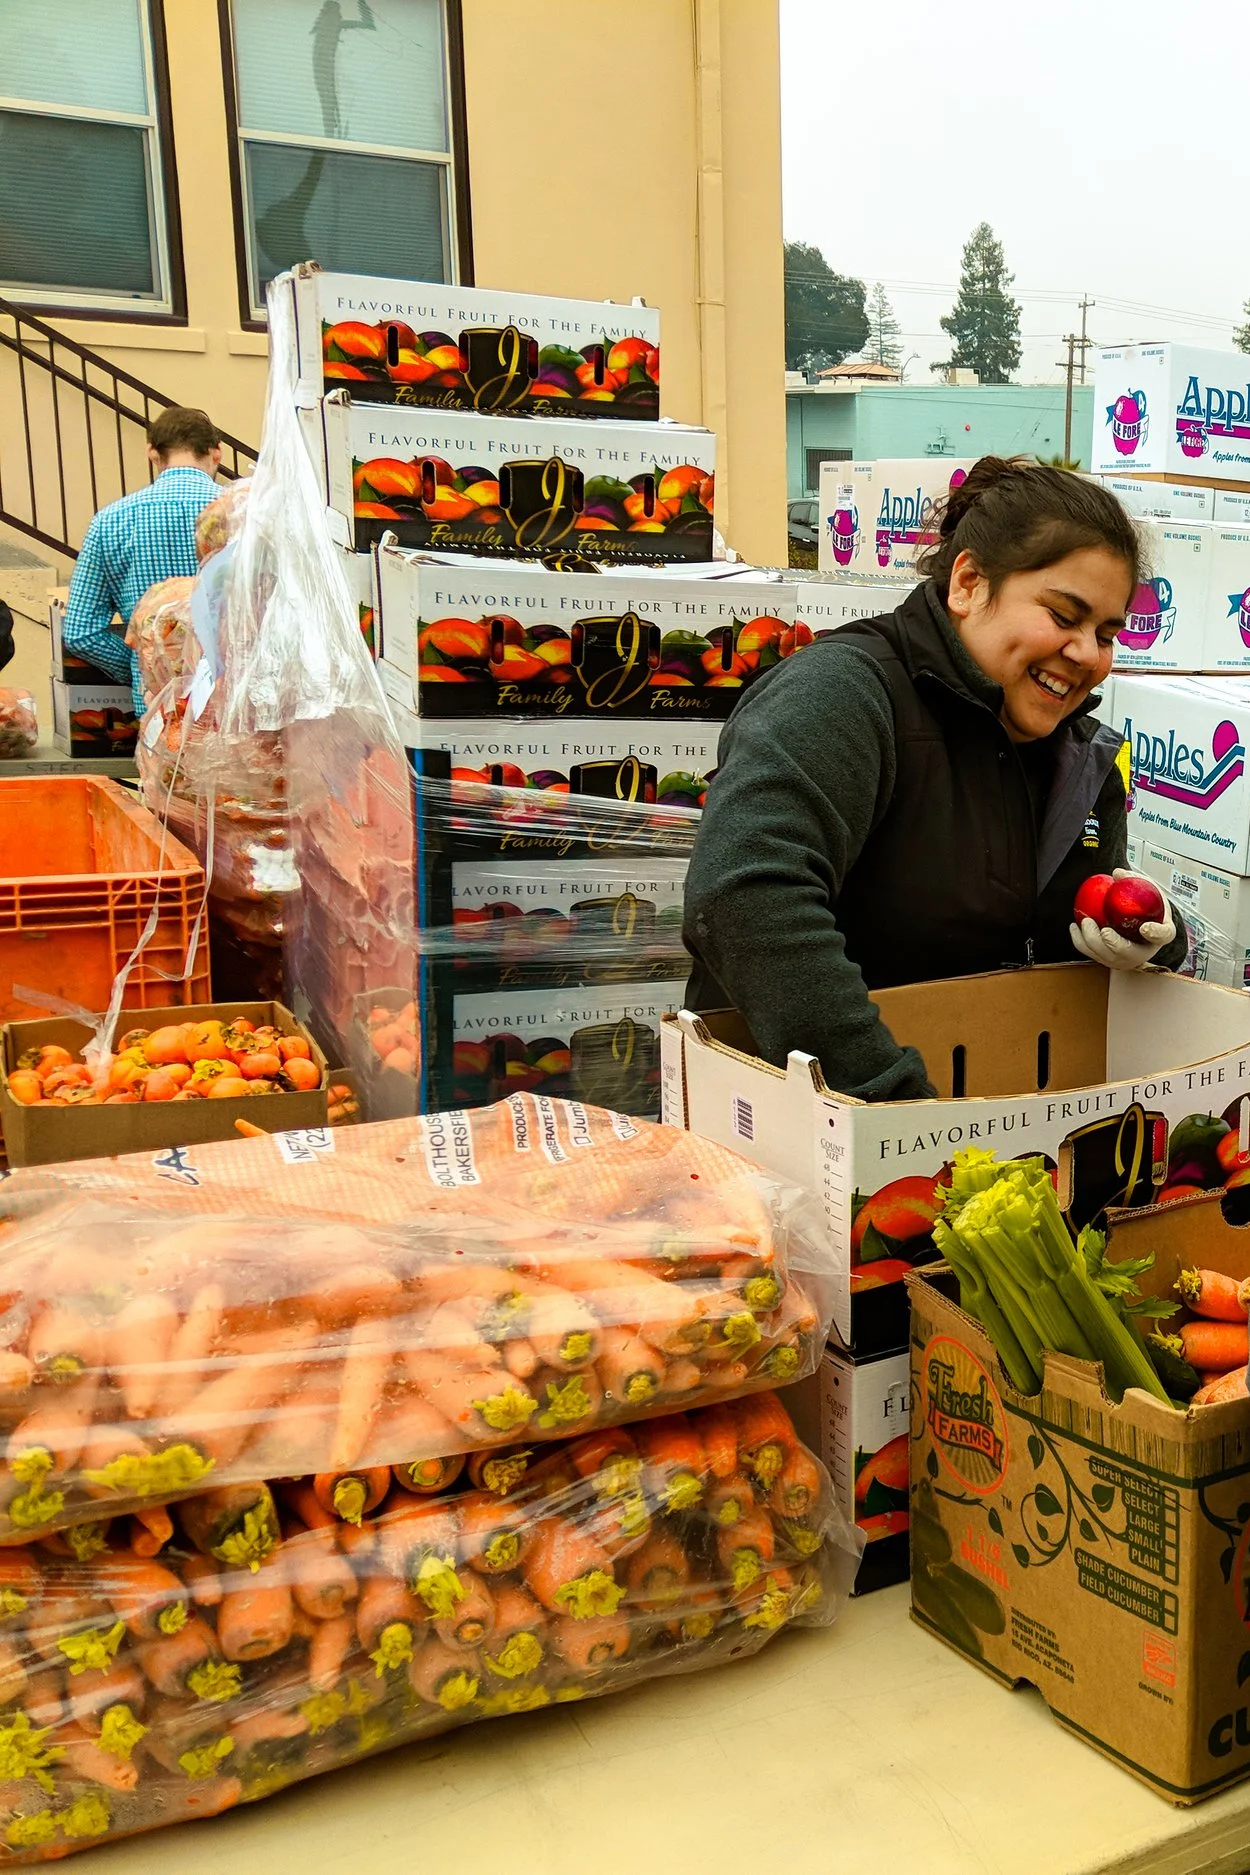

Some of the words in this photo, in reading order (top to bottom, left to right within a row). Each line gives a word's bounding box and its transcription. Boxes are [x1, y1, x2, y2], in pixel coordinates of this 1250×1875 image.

[337, 297, 437, 318] FLAVORFUL
[447, 308, 498, 323] FRUIT
[508, 314, 540, 328] FOR
[550, 319, 580, 333] THE
[591, 323, 647, 338] FAMILY
[368, 432, 477, 451] FLAVORFUL
[487, 440, 541, 456] FRUIT
[553, 445, 586, 459] FOR
[596, 448, 630, 462] THE
[640, 451, 701, 467] FAMILY
[1212, 451, 1235, 463] Apples
[1235, 454, 1250, 464] from
[431, 524, 504, 547] Family
[578, 532, 638, 551] Farms
[434, 591, 548, 609] FLAVORFUL
[559, 597, 616, 611] FRUIT
[627, 600, 663, 613] FOR
[671, 602, 708, 615] THE
[717, 603, 782, 618] FAMILY
[1159, 581, 1170, 603] 4
[1130, 613, 1162, 631] FORE
[496, 685, 574, 715] Family
[650, 691, 711, 711] Farms
[440, 743, 550, 755] FLAVORFUL
[562, 743, 617, 756] FRUIT
[628, 743, 663, 756] FOR
[672, 744, 707, 756] THE
[1122, 717, 1205, 787] Apples
[500, 830, 575, 857] Family
[1138, 807, 1155, 822] Apples
[1155, 813, 1169, 828] from
[1169, 818, 1181, 832] Blue
[1182, 823, 1210, 842] Mountain
[1211, 832, 1237, 853] Country
[452, 884, 547, 897] LAVORFUL
[560, 882, 613, 894] FRUIT
[625, 881, 658, 892] FOR
[453, 1014, 548, 1030] LAVORFUL
[556, 1009, 612, 1024] FRUIT
[624, 1006, 656, 1018] FOR
[512, 1101, 529, 1149] PRODUCE
[569, 1101, 588, 1134] Jumb
[879, 1113, 1031, 1160] FLAVORFUL
[1045, 1092, 1117, 1123] FRUIT
[1131, 1080, 1173, 1102] FOR
[1184, 1068, 1225, 1091] THE
[425, 1112, 457, 1187] BOLTHOUSE
[449, 1110, 476, 1182] BAKERSFIE
[542, 1114, 566, 1162] FRIGERATE
[820, 1138, 845, 1155] COUNT
[826, 1150, 840, 1163] SIZE
[823, 1178, 831, 1187] 44
[823, 1193, 831, 1201] 42
[928, 1358, 995, 1427] Fresh
[939, 1417, 991, 1451] FARMS
[1092, 1461, 1122, 1484] SUPER
[1124, 1475, 1160, 1499] SELECT
[1124, 1492, 1160, 1517] SELECT
[1129, 1511, 1160, 1536] LARGE
[1128, 1529, 1160, 1553] SMALL
[1131, 1548, 1160, 1572] PLAIN
[1077, 1552, 1105, 1576] SHADE
[1107, 1567, 1160, 1603] CUCUMBER
[1081, 1572, 1105, 1594] FIELD
[1107, 1586, 1160, 1622] CUCUMBER
[1011, 1616, 1034, 1637] FRESH
[1034, 1630, 1060, 1652] FARMS
[1011, 1639, 1023, 1652] RIO
[1138, 1681, 1162, 1699] GROWN
